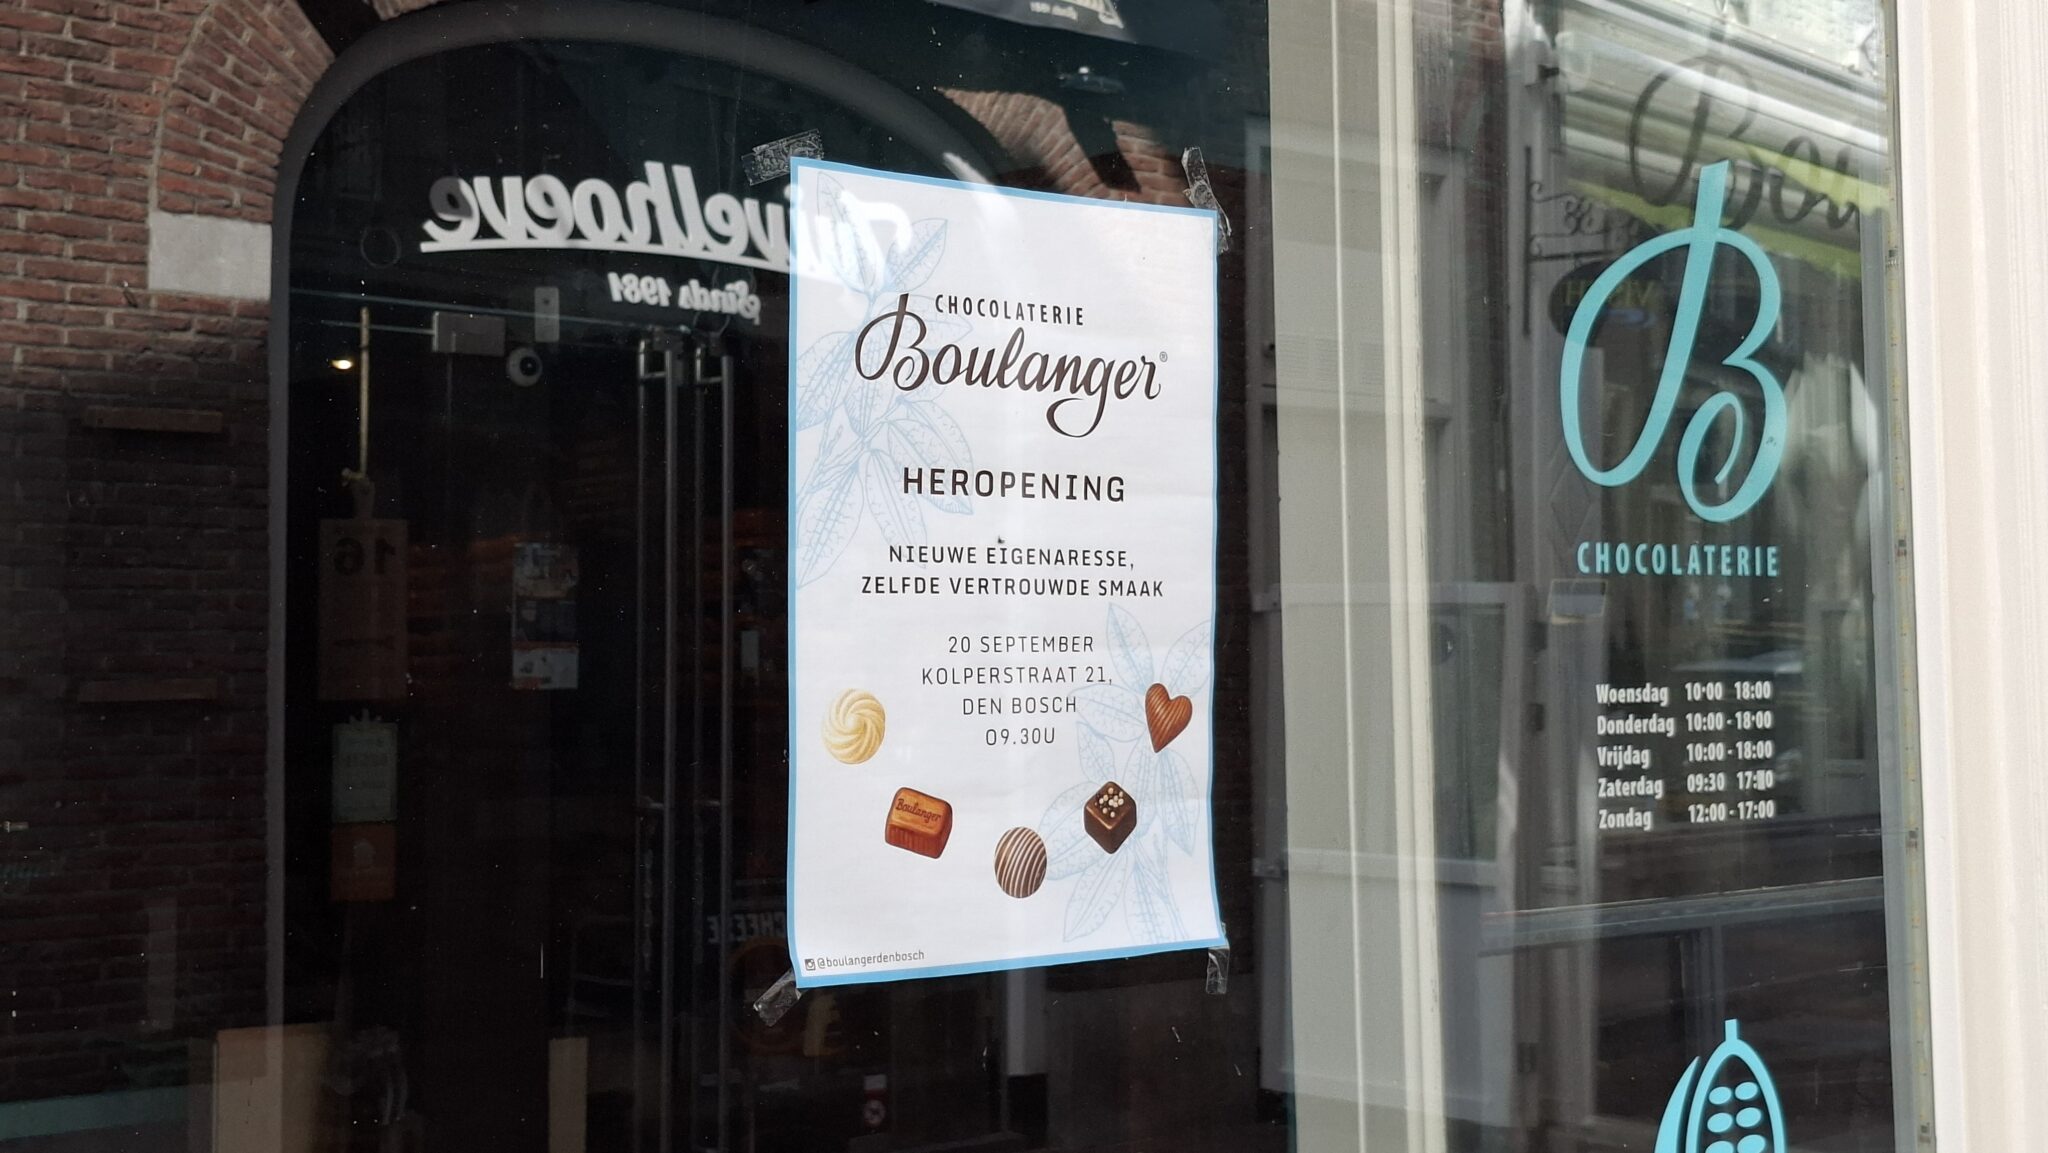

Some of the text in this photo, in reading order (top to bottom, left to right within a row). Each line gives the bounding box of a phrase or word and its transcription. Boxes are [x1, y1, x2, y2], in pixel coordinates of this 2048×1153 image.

[935, 294, 1085, 326] CHOCOLATERIE
[1561, 161, 1788, 524] B
[903, 466, 1125, 503] HEROPENING
[889, 545, 1135, 570] NIEUWE EIGENARESSE,
[1576, 542, 1780, 577] CHOCOLATERIE
[861, 576, 1164, 597] ZELFDE VERTROUWDE SMAAK
[948, 635, 1094, 653] 20 SEPTEMBER
[922, 666, 1113, 686] KOLPERSTRAAT 21,
[963, 696, 1077, 716] DEN BOSCH
[1596, 682, 1670, 707] Woensdag
[1734, 681, 1772, 700] 18:00
[1597, 713, 1676, 737] Donderdag
[1686, 712, 1724, 731] 10:00
[1597, 745, 1651, 770] Vrijdag
[1686, 742, 1725, 762] 10:00
[1735, 740, 1773, 760] 18:00
[1598, 776, 1664, 800] Zaterdag
[1687, 772, 1726, 793] 09:30
[895, 798, 941, 823] Boulanger
[1598, 807, 1653, 831] Zondag
[1688, 802, 1726, 824] 12:00
[1737, 800, 1775, 820] 17:00
[816, 950, 925, 970] @boulangerdenbosch
